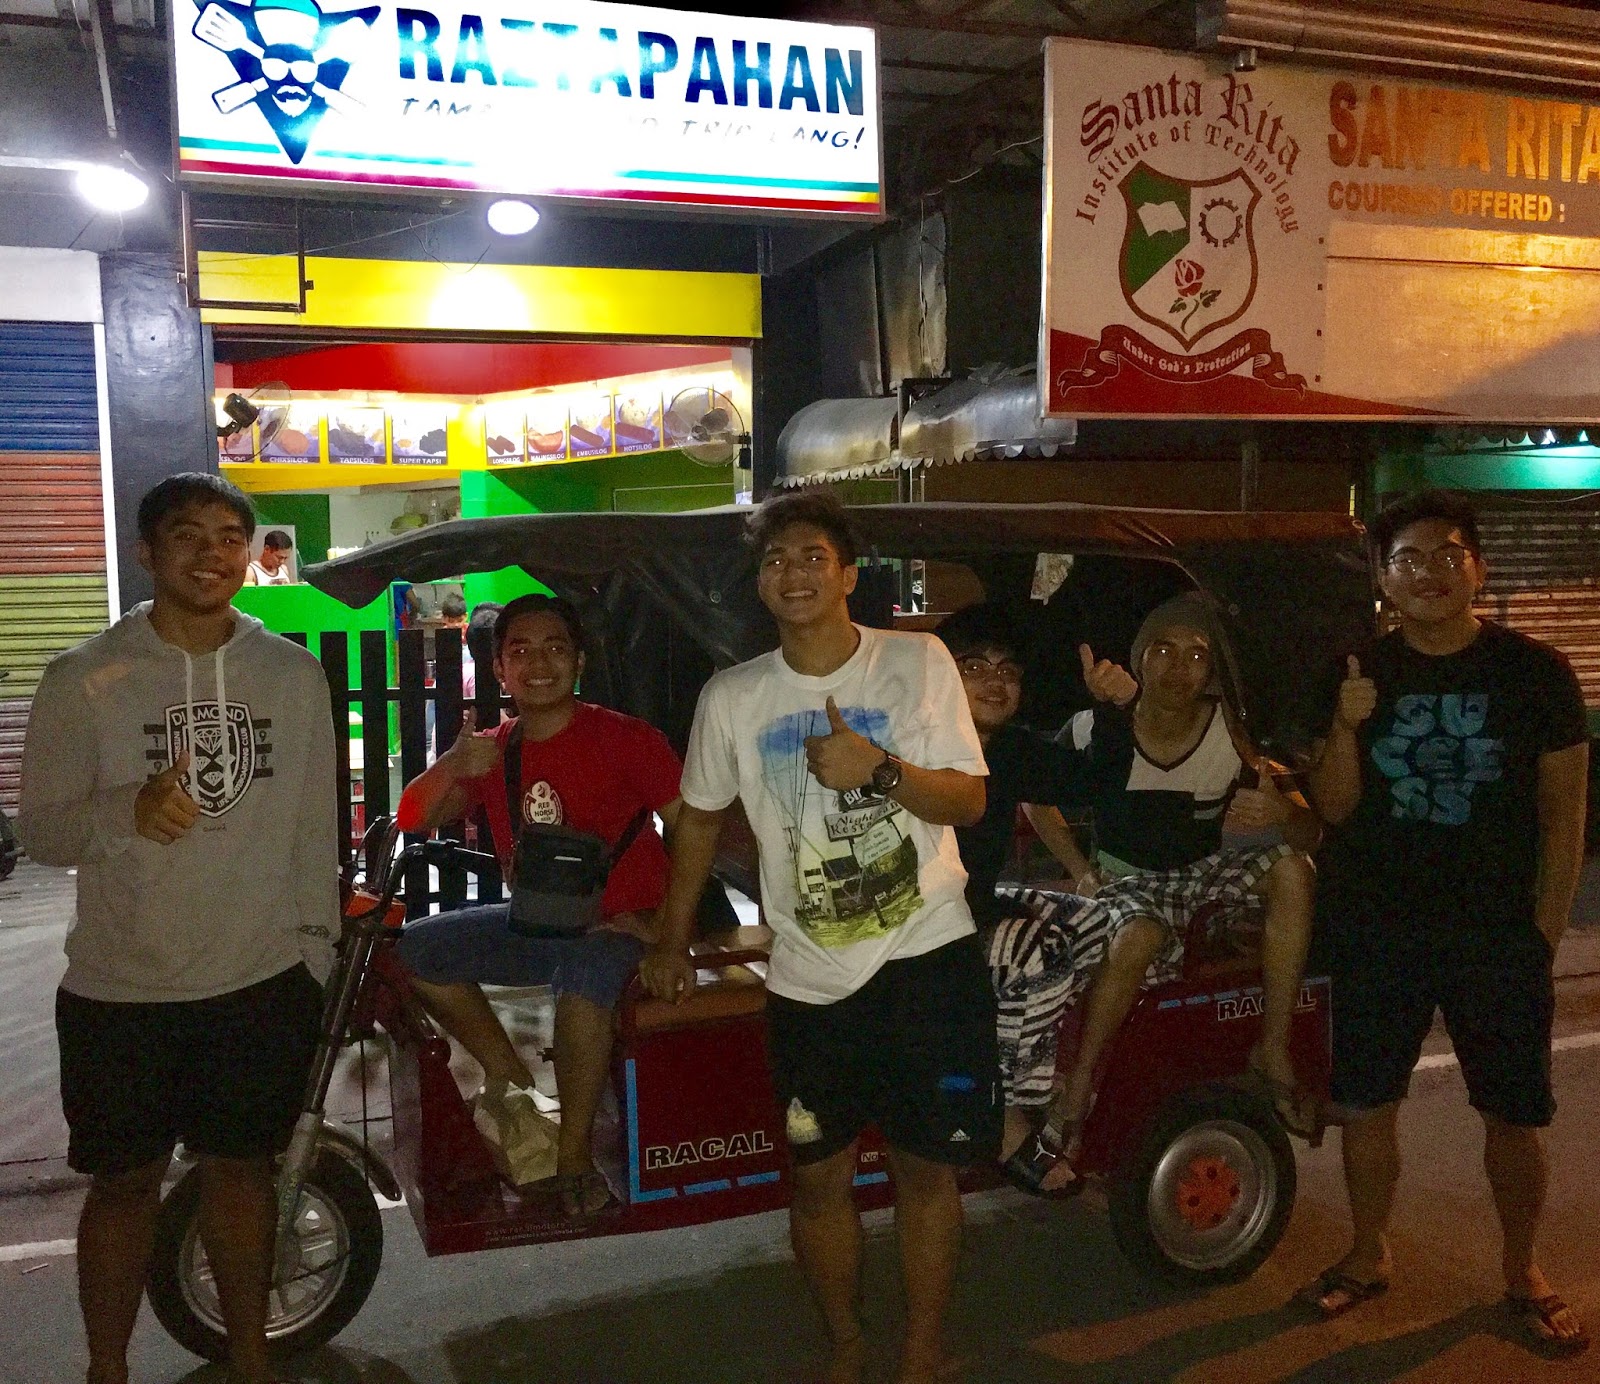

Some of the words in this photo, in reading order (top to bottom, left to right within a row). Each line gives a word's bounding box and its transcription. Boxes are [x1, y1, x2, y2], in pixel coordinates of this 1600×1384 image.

[1079, 71, 1204, 163] Santa
[1220, 73, 1301, 175] Rita
[1076, 130, 1160, 225] Institute
[1170, 120, 1192, 142] of
[1205, 123, 1300, 234] Technology
[1450, 188, 1552, 222] OFFERED
[1123, 336, 1154, 366] Under
[1158, 358, 1191, 375] God's
[1194, 342, 1251, 374] Protection
[623, 443, 653, 452] HOTSILOG
[1217, 987, 1317, 1022] RAL
[645, 1131, 773, 1170] RACAL
